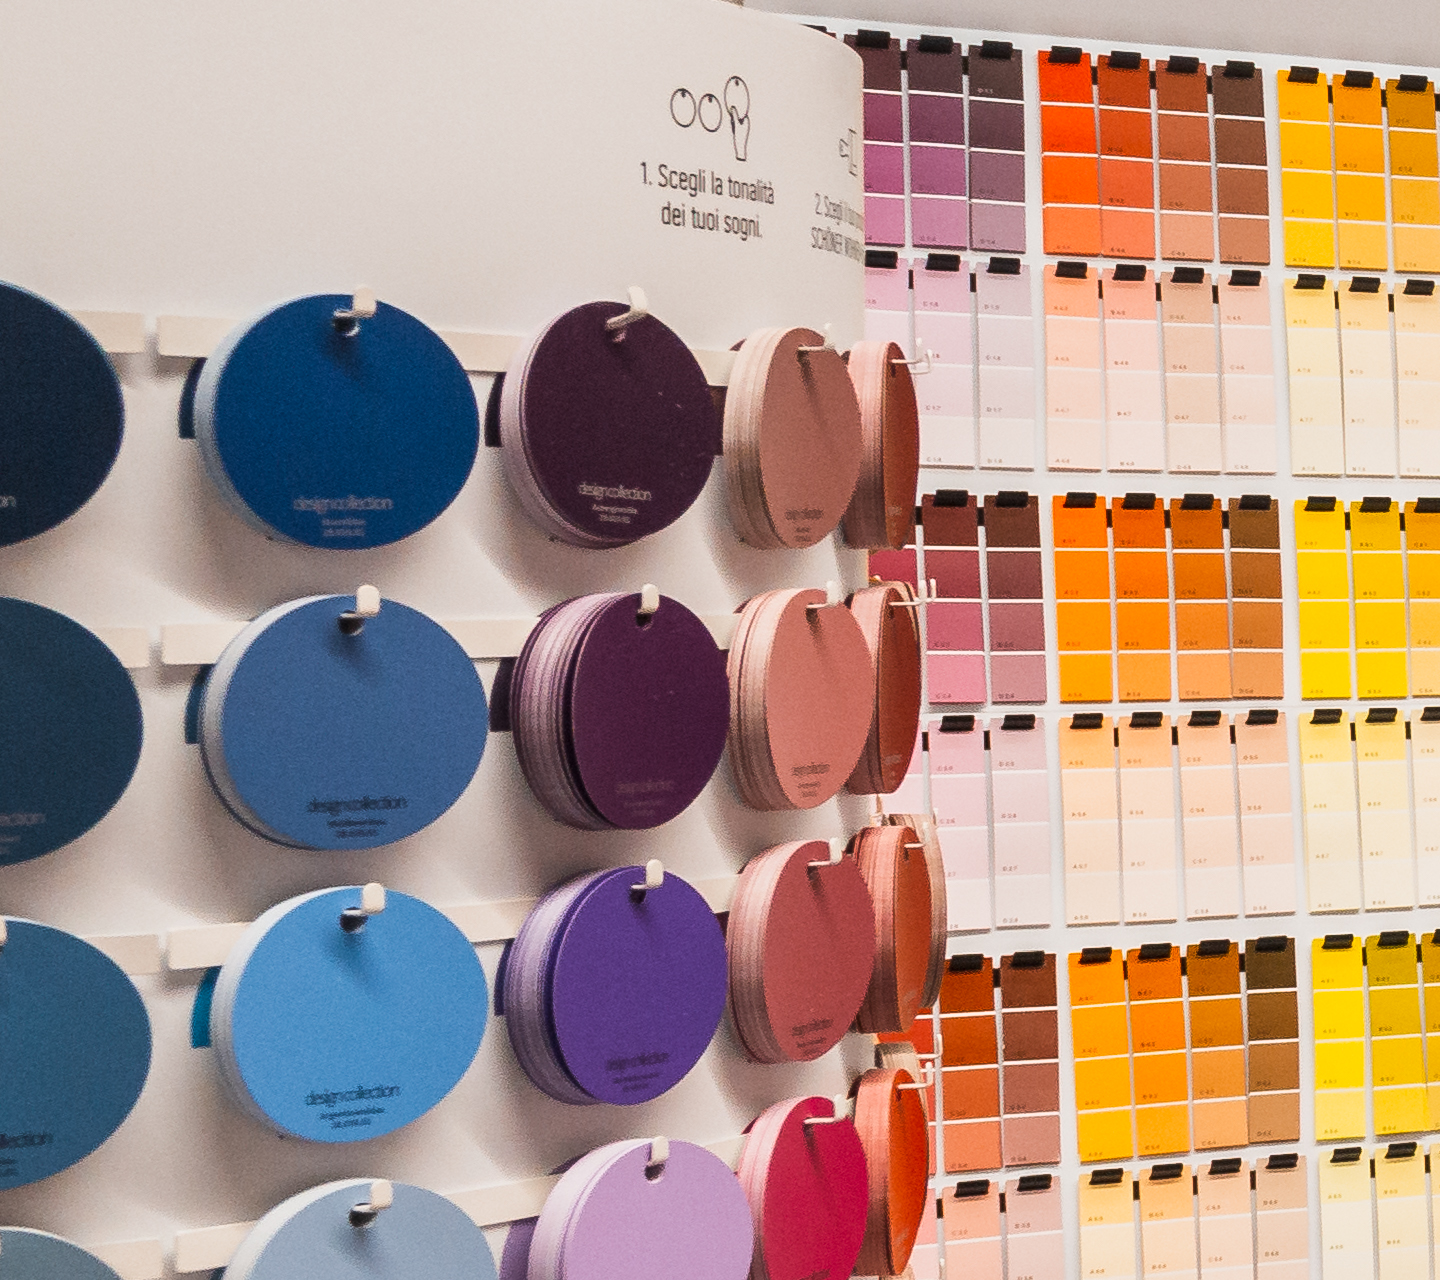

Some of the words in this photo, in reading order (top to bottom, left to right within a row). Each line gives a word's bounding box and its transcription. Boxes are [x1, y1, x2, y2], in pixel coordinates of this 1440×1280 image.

[641, 162, 653, 186] 1.
[658, 164, 706, 197] Scegli
[711, 171, 723, 196] la
[728, 176, 774, 205] tonalità
[661, 202, 686, 227] dei
[691, 207, 719, 231] tuoi
[724, 214, 763, 241] sogni.
